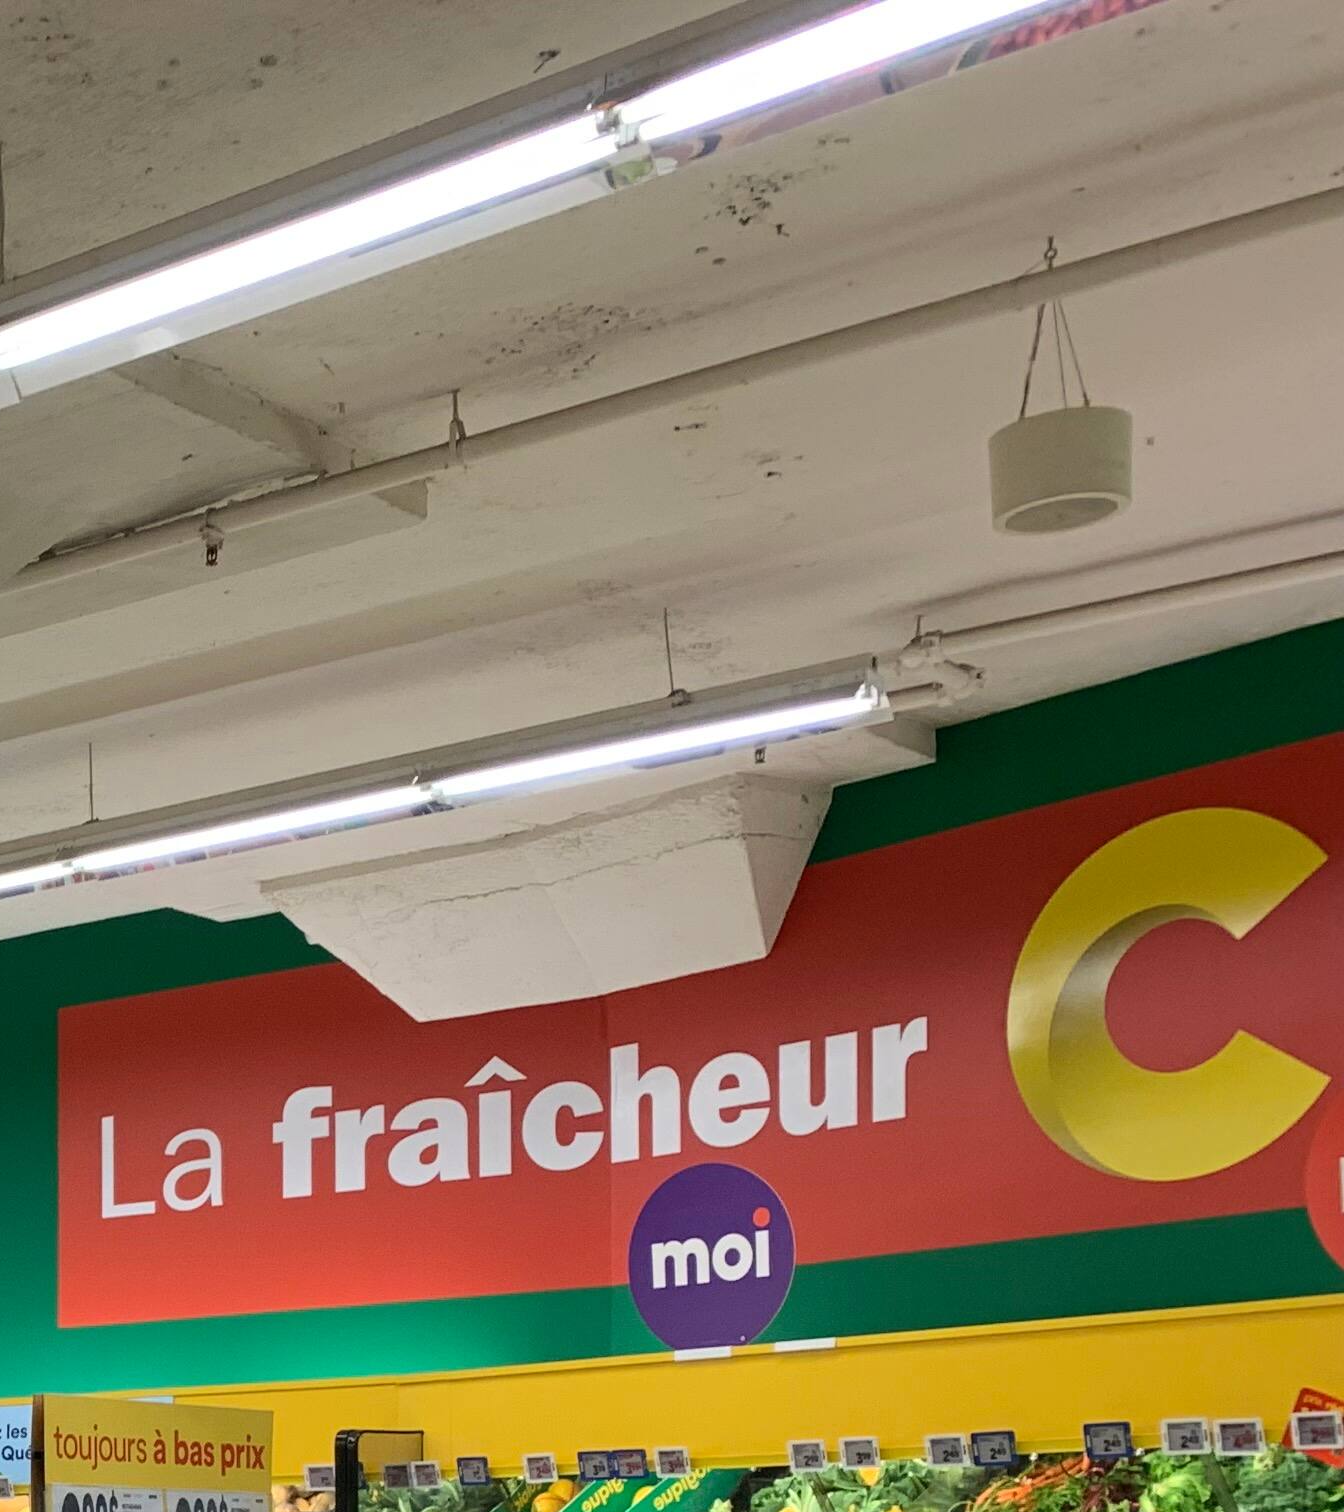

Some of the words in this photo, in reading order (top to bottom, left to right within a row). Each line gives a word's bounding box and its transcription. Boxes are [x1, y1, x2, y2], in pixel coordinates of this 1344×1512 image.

[100, 1116, 223, 1219] La
[272, 1015, 928, 1199] fraîcheur
[652, 1206, 770, 1289] moi
[1, 1444, 32, 1462] Qué
[6, 1423, 28, 1440] les
[53, 1424, 148, 1471] toujours
[153, 1429, 166, 1464] à
[174, 1430, 215, 1467] bas
[220, 1434, 265, 1476] prix
